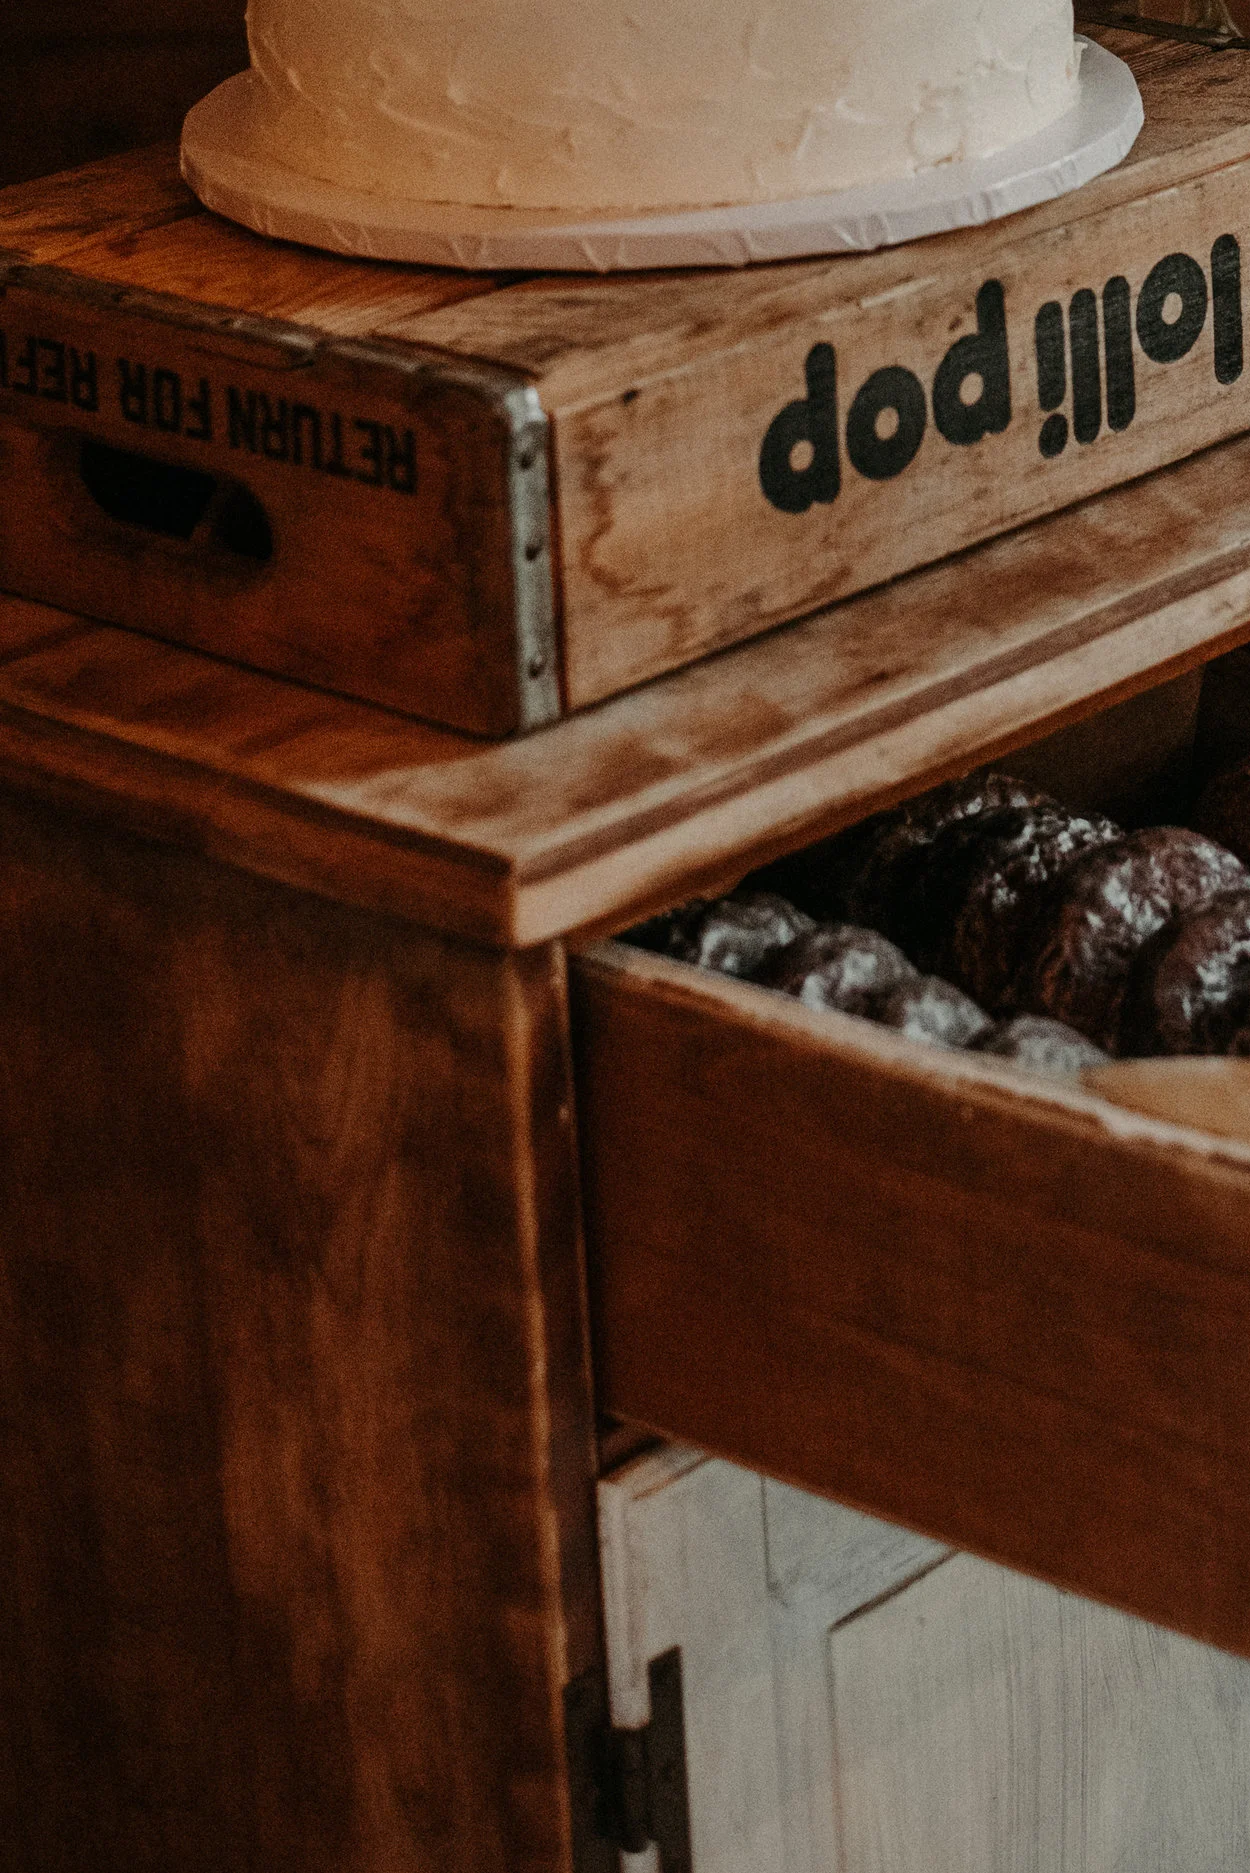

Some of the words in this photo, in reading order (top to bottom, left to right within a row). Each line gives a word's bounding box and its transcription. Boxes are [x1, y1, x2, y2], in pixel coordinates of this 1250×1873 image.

[0, 330, 99, 412] REF
[117, 356, 212, 442] FOR
[225, 384, 418, 495] RETURN
